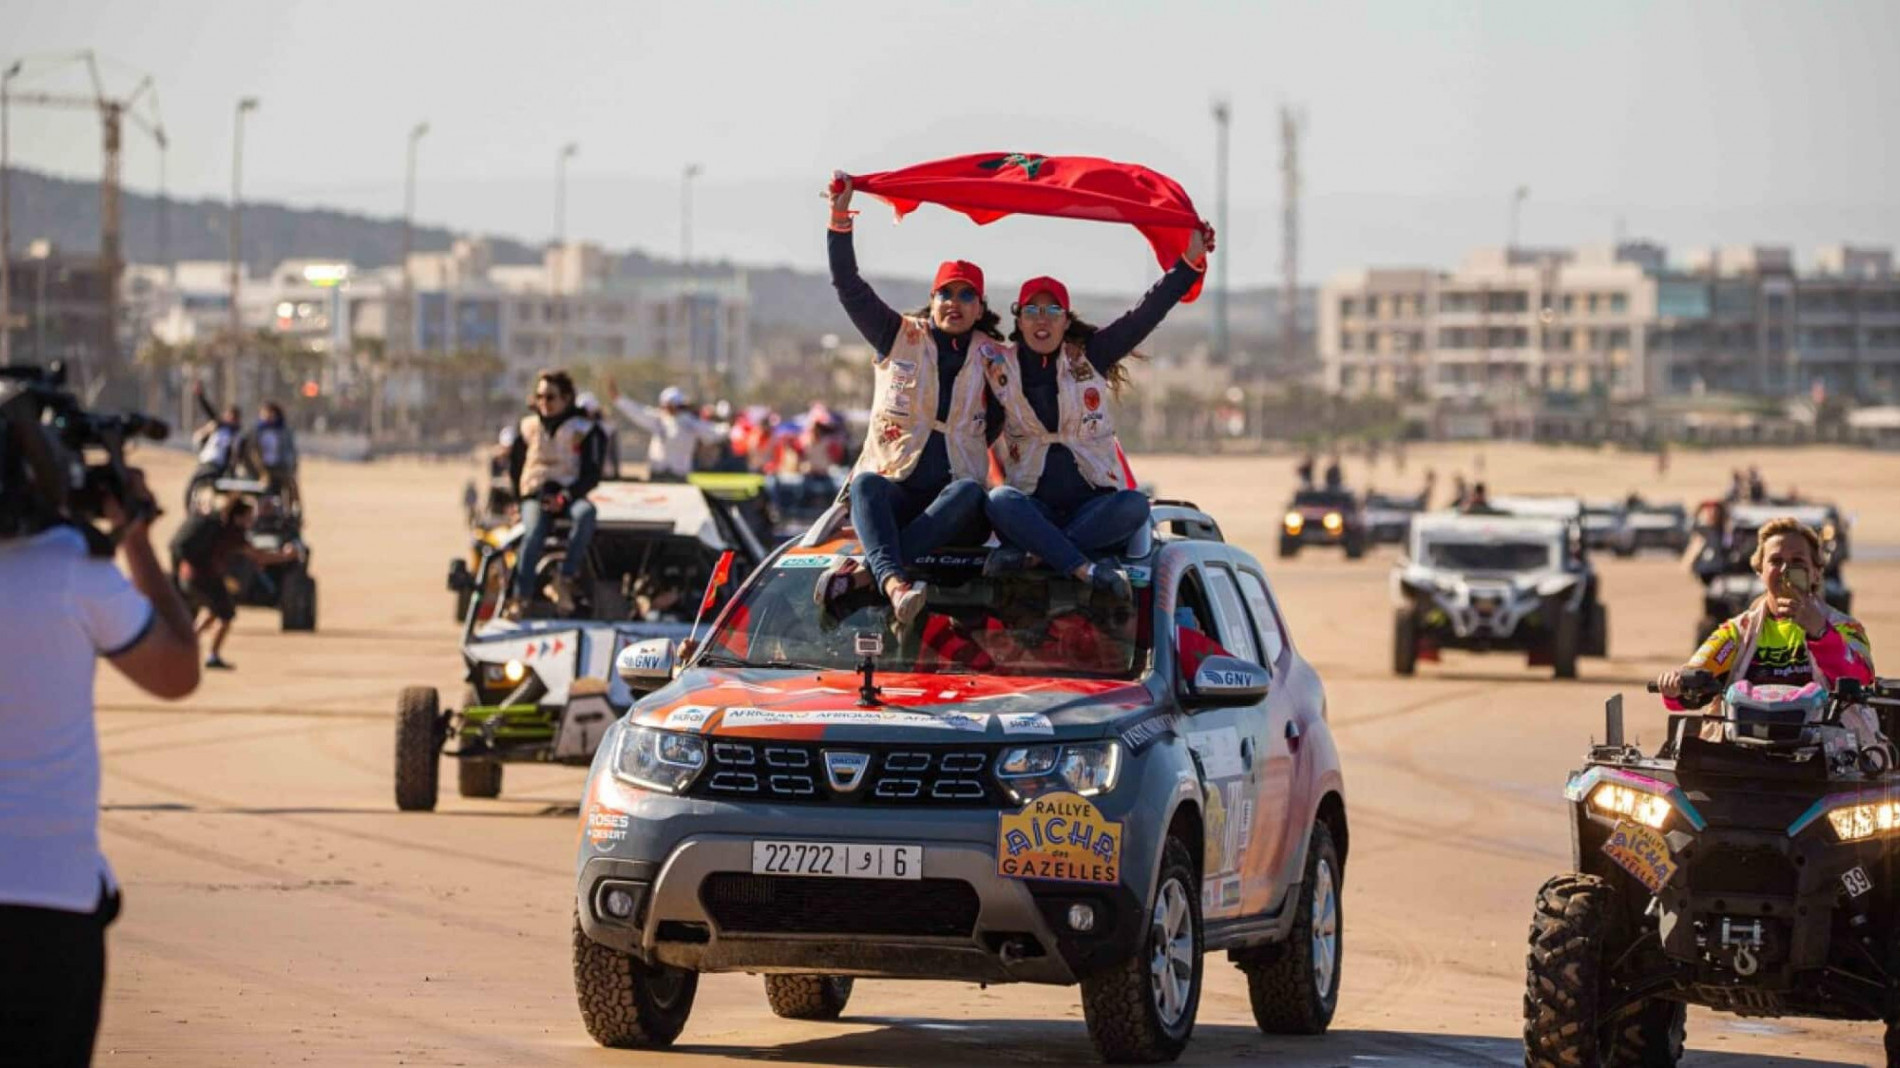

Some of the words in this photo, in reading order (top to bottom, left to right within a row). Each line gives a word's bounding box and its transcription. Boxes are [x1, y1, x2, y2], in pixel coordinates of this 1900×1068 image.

[939, 556, 970, 565] Car
[635, 655, 660, 670] GNV
[1224, 671, 1253, 687] GNV
[1035, 801, 1091, 818] RALLYE
[589, 813, 629, 828] ROSES
[764, 843, 834, 874] 22722
[856, 851, 872, 870] و
[894, 847, 907, 876] 6
[1002, 858, 1116, 882] GAZELLES
[1844, 867, 1868, 896] 39
